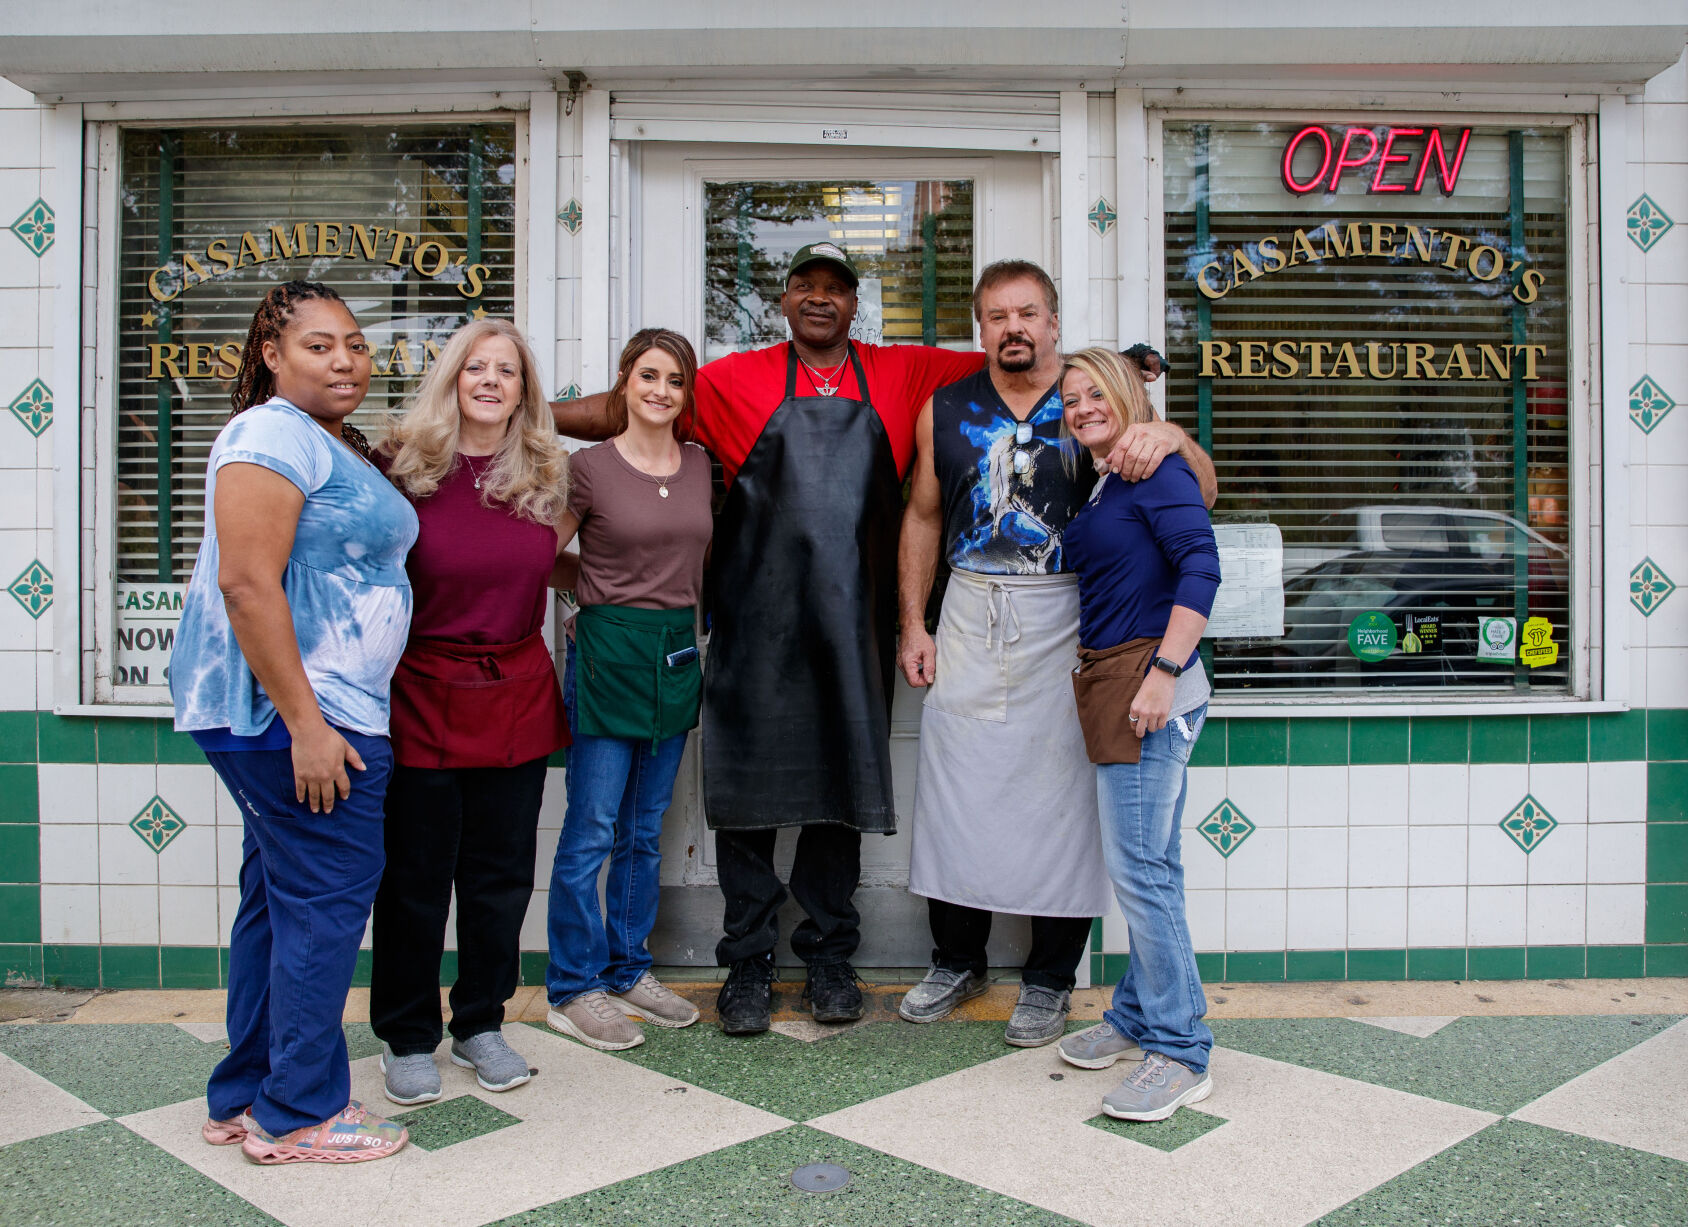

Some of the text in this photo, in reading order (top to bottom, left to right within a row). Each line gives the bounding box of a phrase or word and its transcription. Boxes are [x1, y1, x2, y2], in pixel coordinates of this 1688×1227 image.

[1281, 126, 1472, 196] OPEN
[147, 222, 491, 303] CASAMENTO'S
[1196, 222, 1547, 304] CASAMENTO'S
[1197, 340, 1548, 382] RESTAURANT
[1356, 633, 1389, 646] FAVE
[328, 1133, 363, 1145] JUST
[363, 1136, 382, 1148] SO
